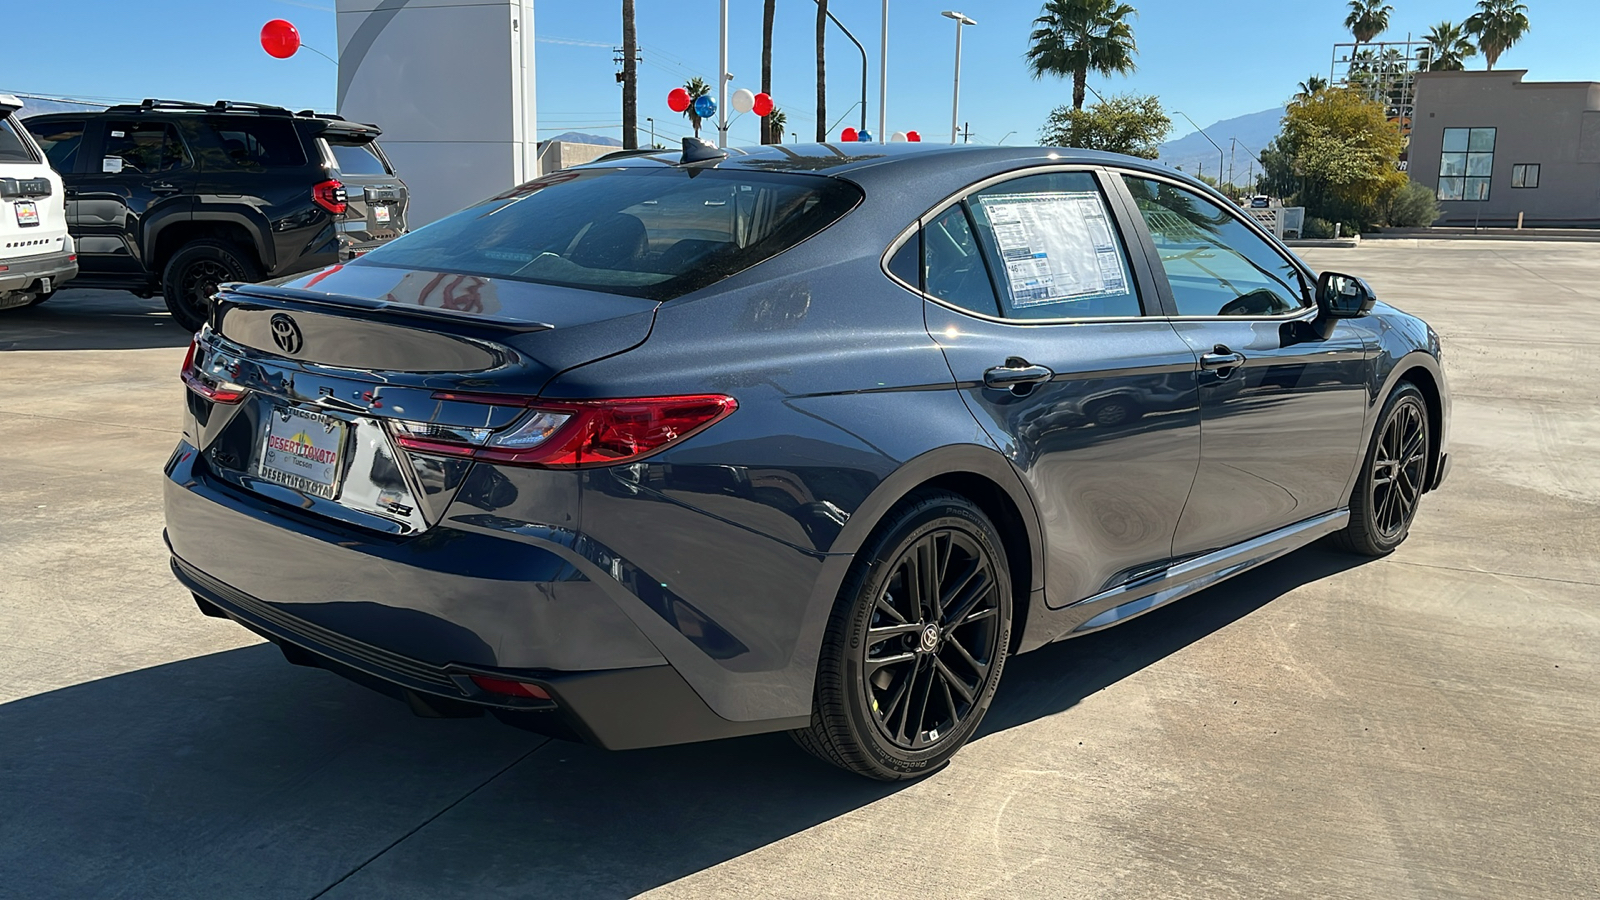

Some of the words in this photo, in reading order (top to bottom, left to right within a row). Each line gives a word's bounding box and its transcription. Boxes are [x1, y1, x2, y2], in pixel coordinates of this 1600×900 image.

[287, 406, 325, 423] TUCSON
[269, 435, 300, 453] DESERT
[303, 444, 336, 464] TOYOTA
[292, 457, 313, 469] Tucson
[261, 466, 291, 485] DESERT
[294, 476, 330, 497] TOYOTA
